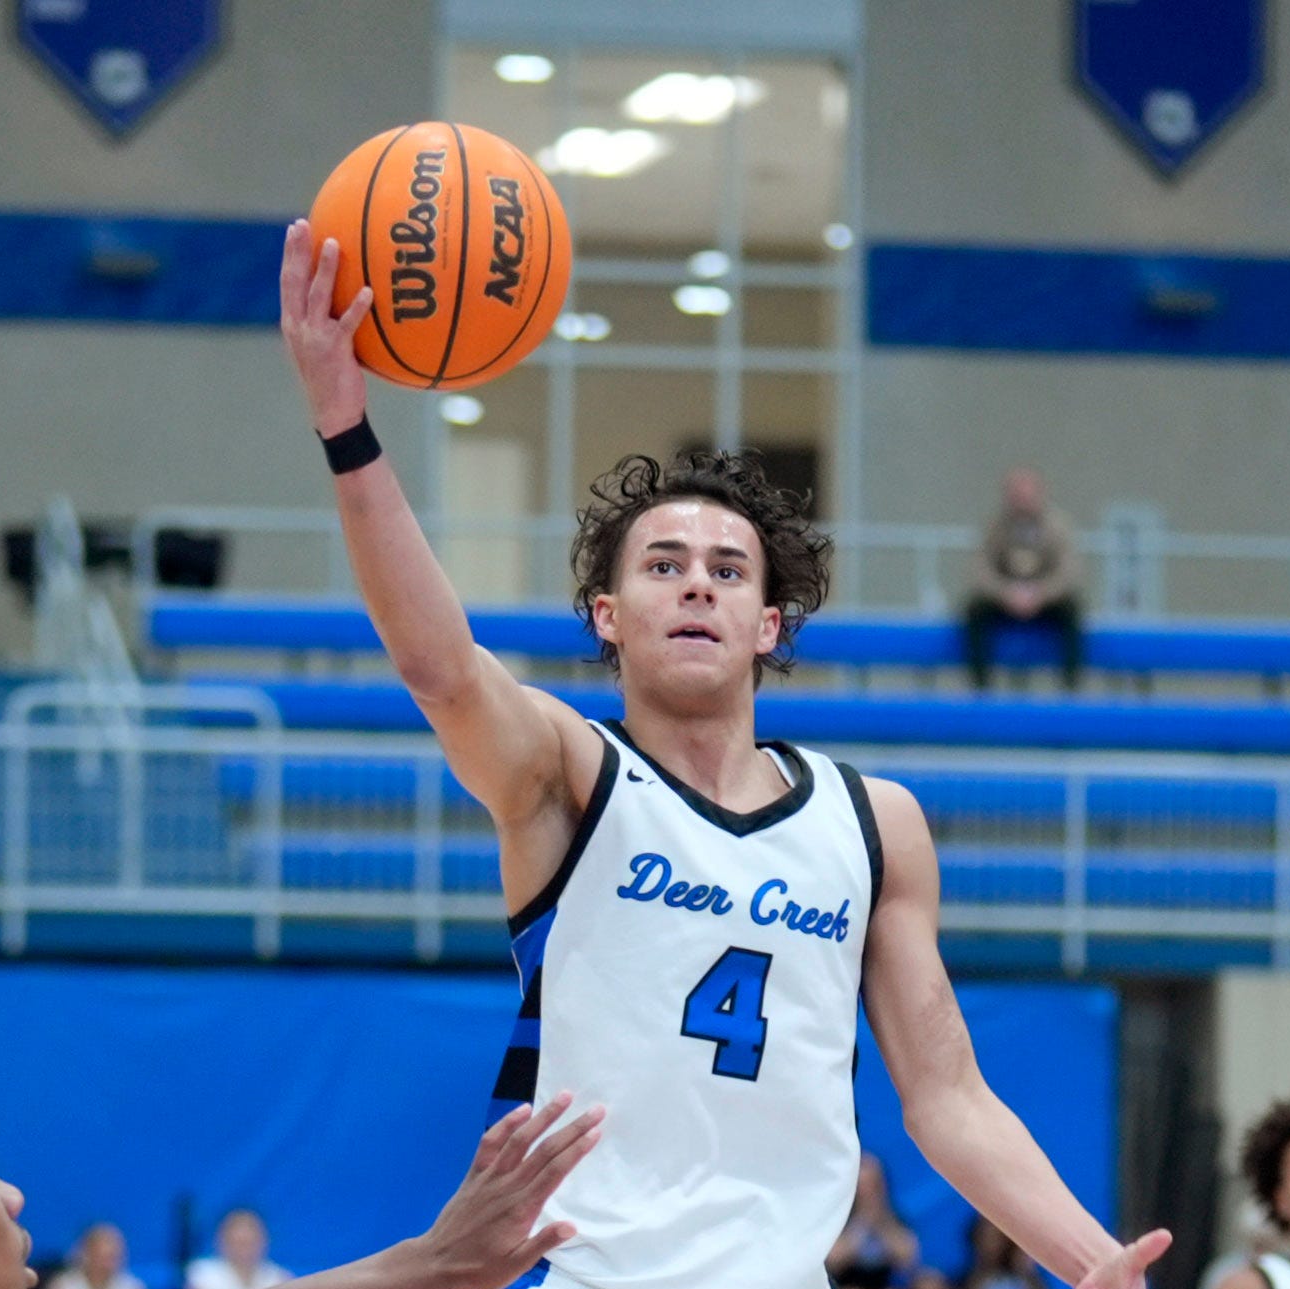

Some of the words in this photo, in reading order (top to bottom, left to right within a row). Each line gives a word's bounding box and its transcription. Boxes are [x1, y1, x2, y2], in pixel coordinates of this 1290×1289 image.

[390, 149, 447, 324] Wilson
[484, 176, 525, 307] NCAA
[616, 852, 733, 916] Deer
[749, 878, 851, 943] Creek
[680, 945, 774, 1083] 4
